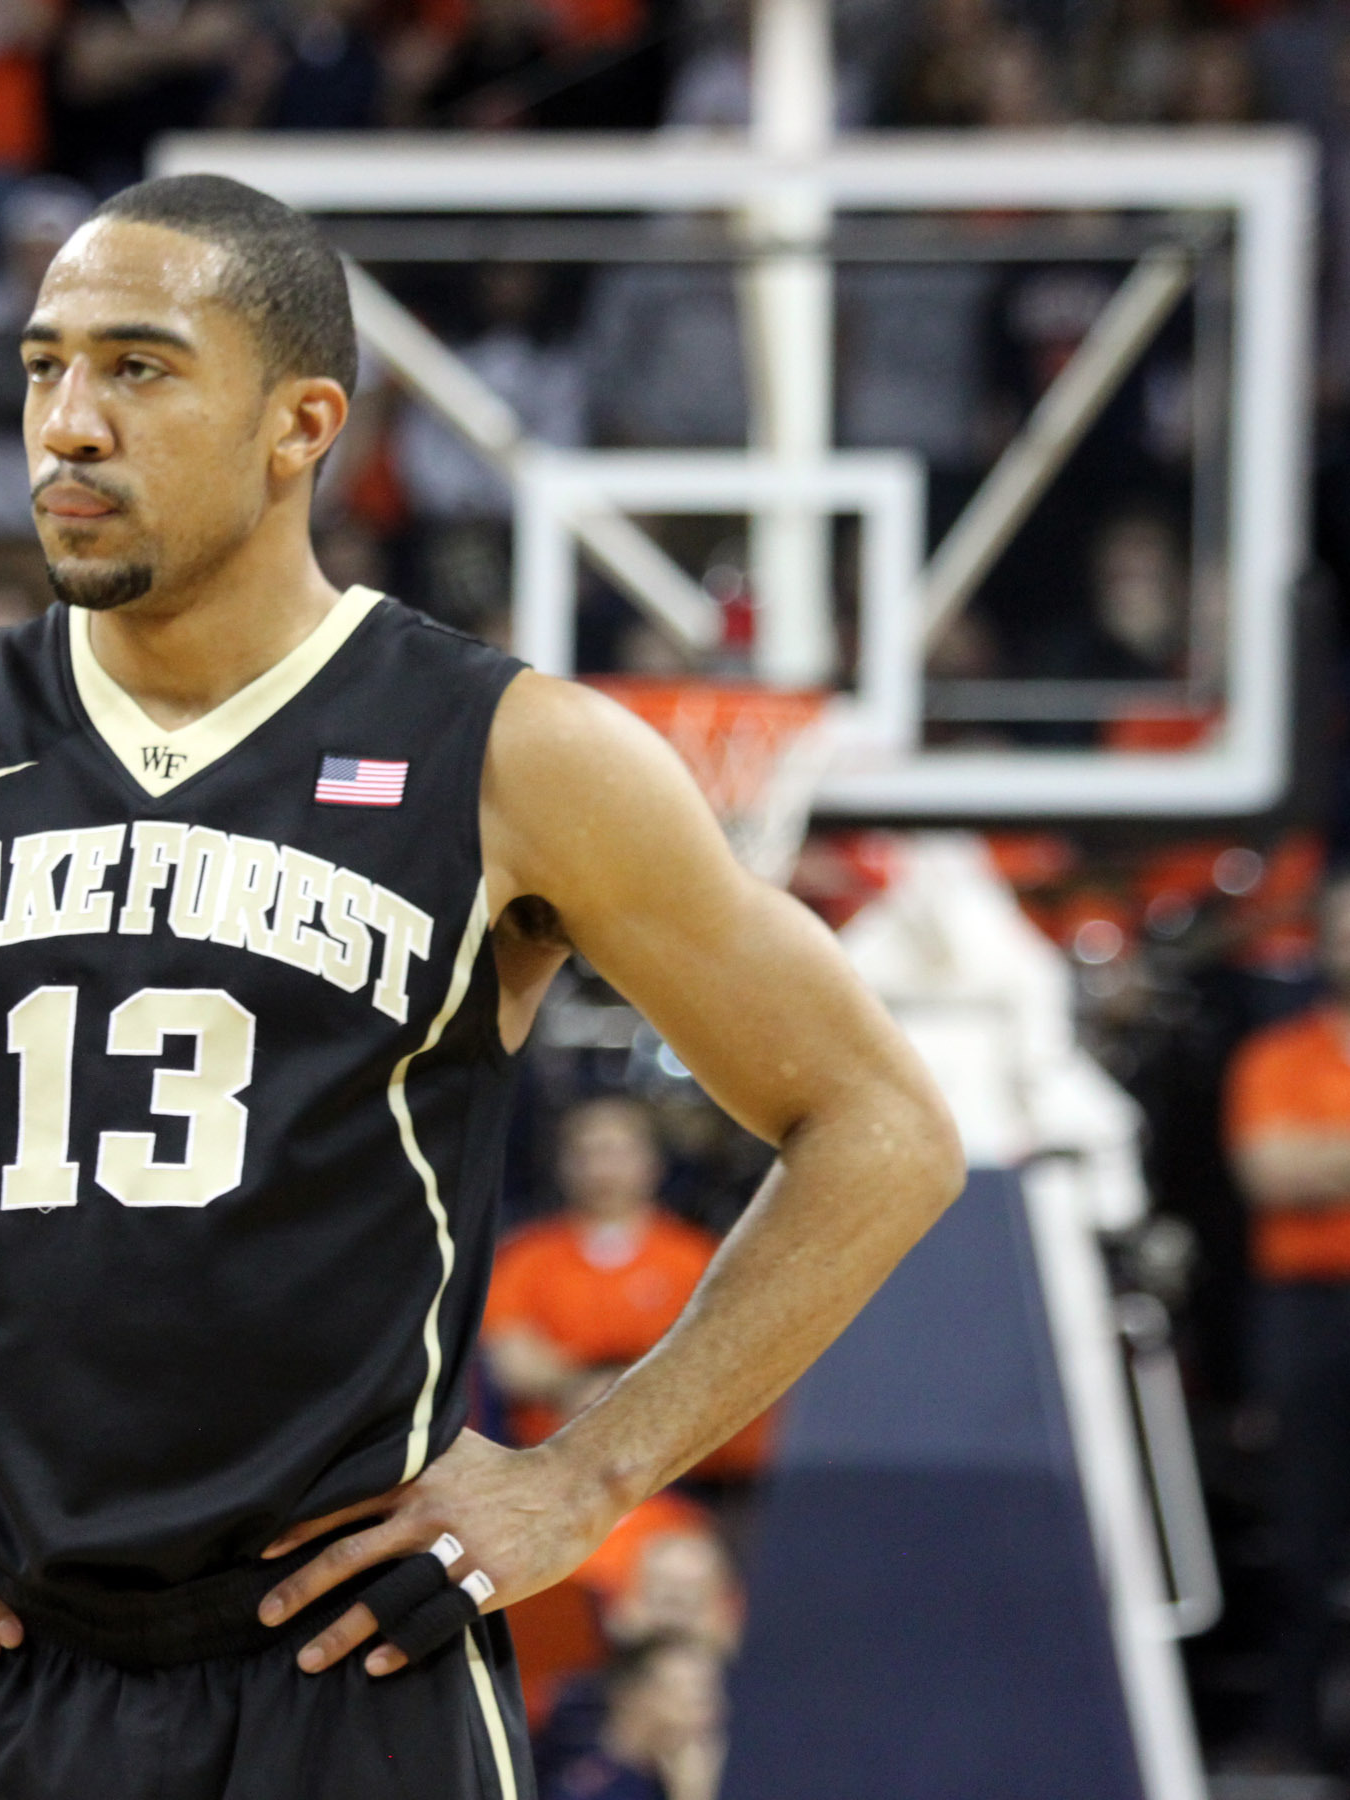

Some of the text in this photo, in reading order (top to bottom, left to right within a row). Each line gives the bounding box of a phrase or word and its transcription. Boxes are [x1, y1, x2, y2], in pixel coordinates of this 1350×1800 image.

[141, 746, 187, 779] WF
[118, 820, 434, 1025] FOREST
[0, 985, 256, 1211] 13
